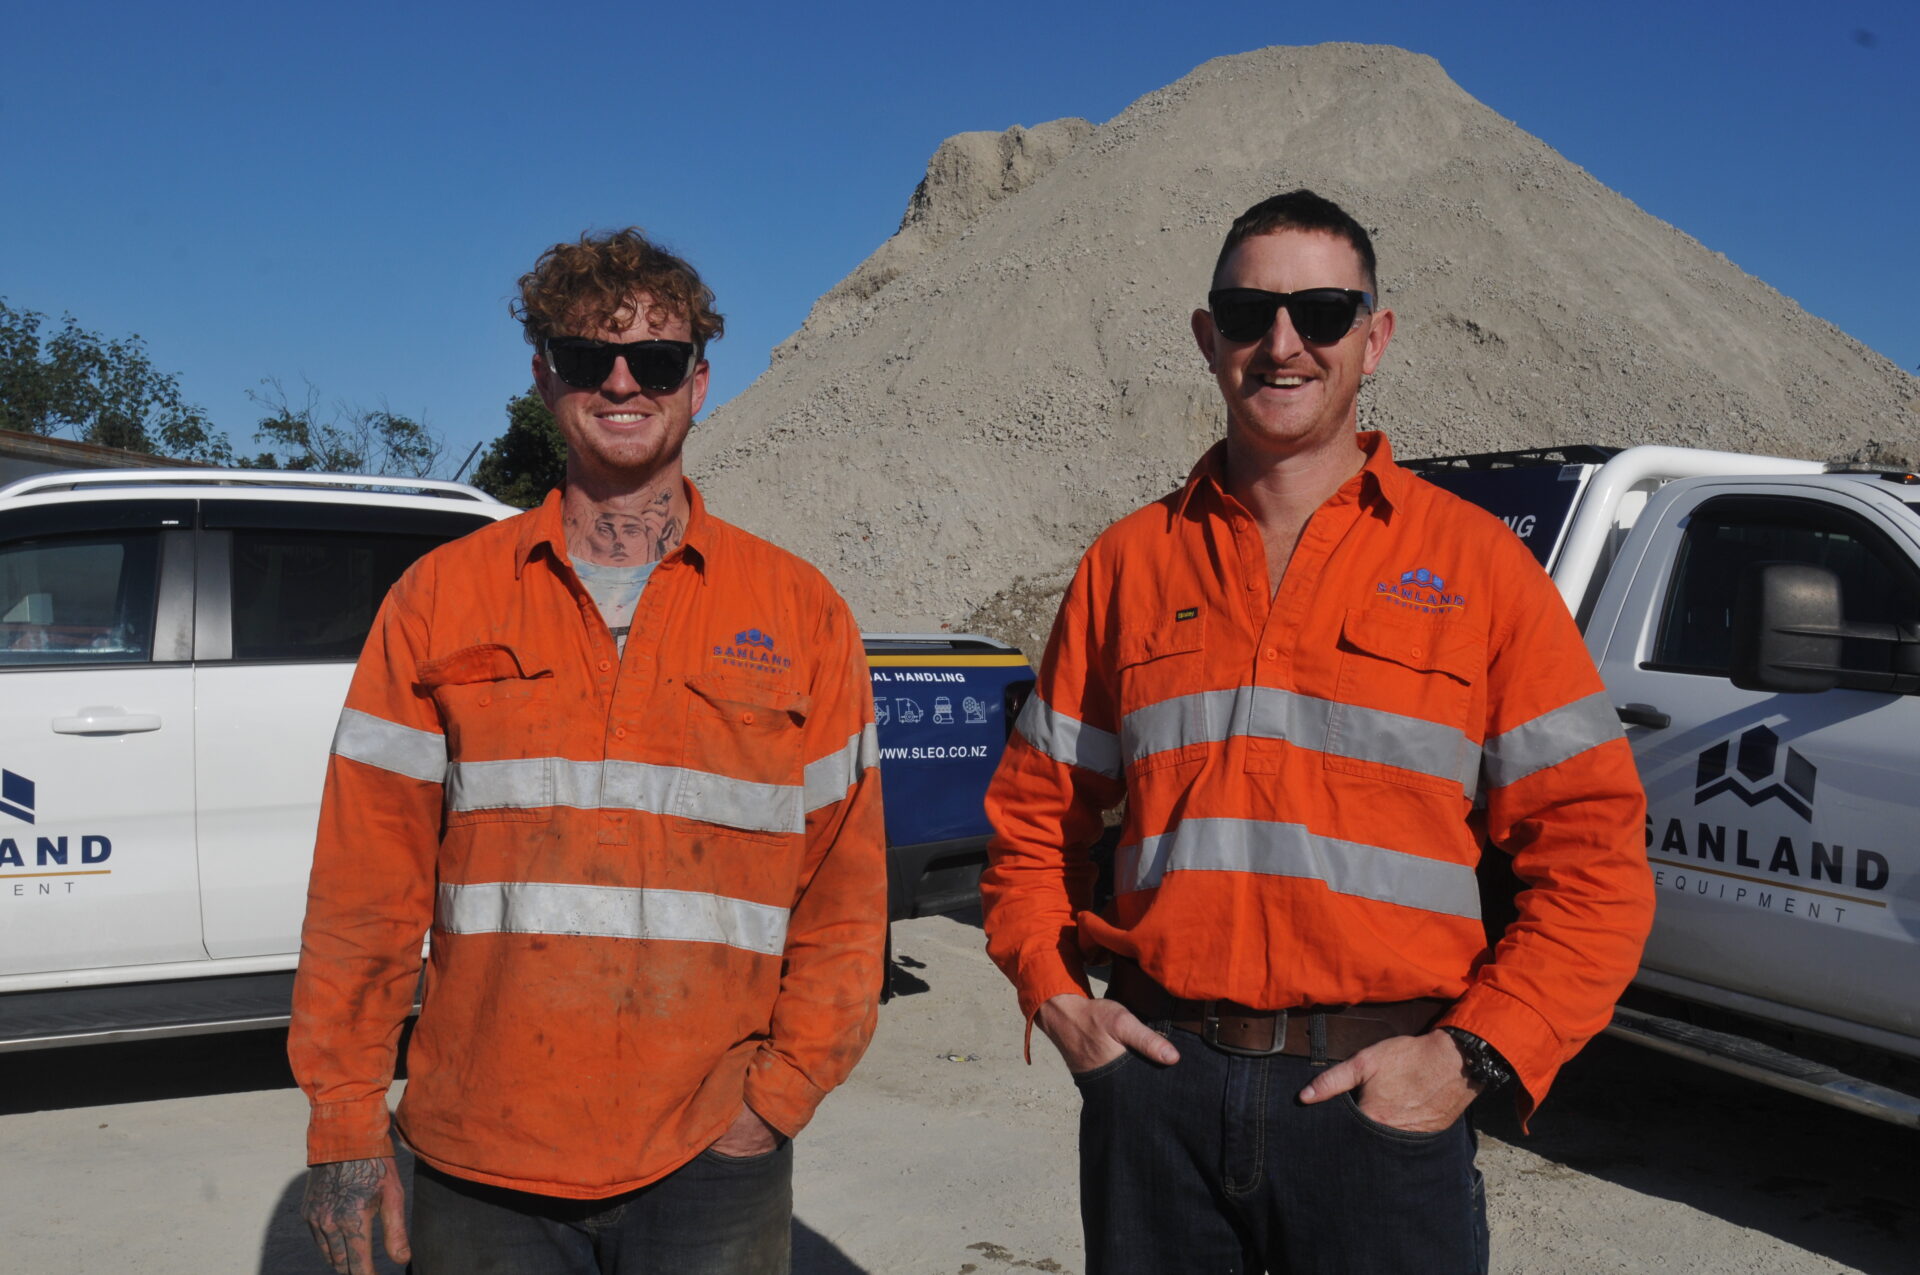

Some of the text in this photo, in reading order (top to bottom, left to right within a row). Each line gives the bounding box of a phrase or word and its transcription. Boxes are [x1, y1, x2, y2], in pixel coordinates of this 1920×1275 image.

[1376, 582, 1465, 606] SANLAND
[713, 646, 791, 668] SANLAND
[870, 672, 965, 682] AL HANDLING
[14, 882, 74, 896] ENT
[1655, 871, 1846, 923] EQUIPMENT
